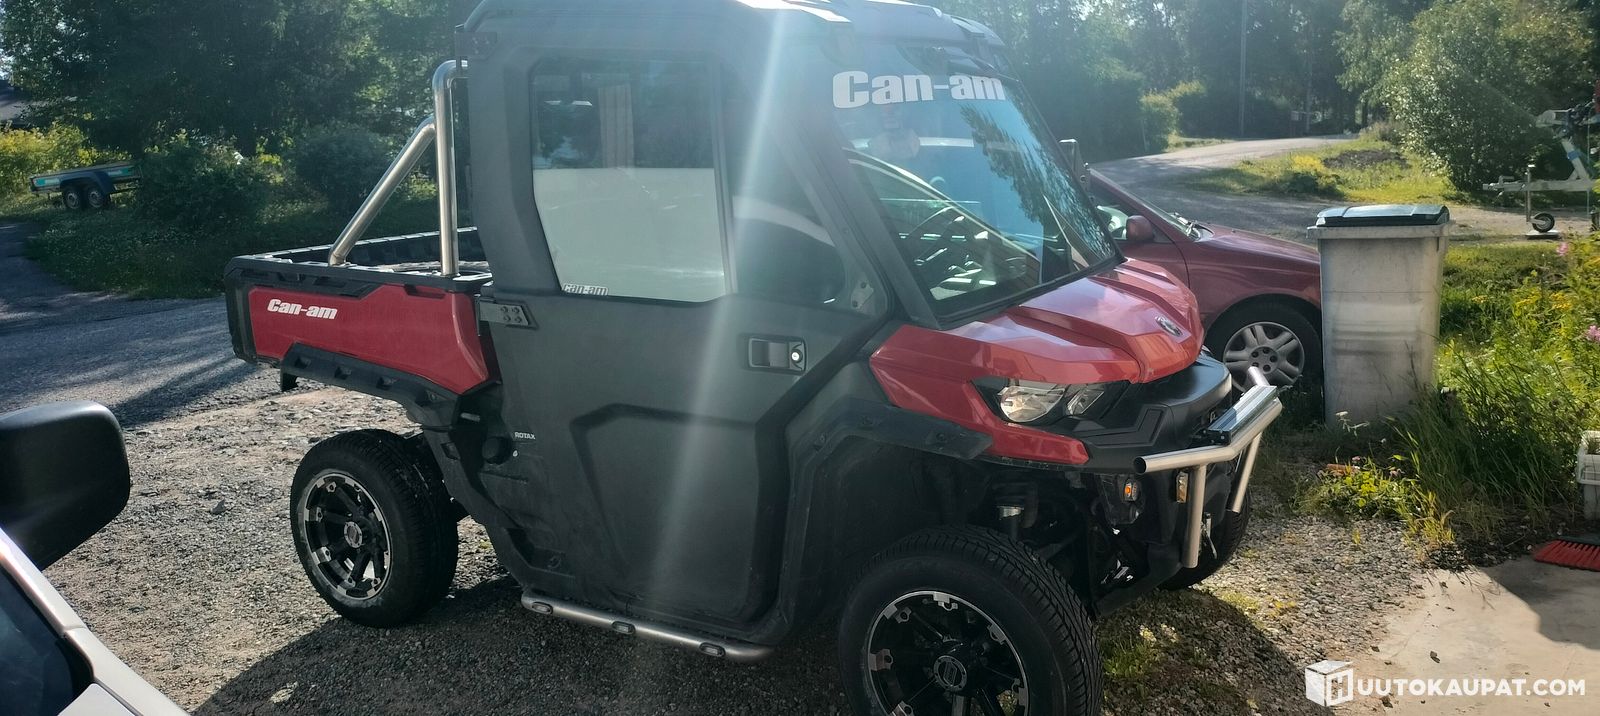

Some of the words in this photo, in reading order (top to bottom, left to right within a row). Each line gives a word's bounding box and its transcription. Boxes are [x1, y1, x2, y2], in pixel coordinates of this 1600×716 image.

[833, 71, 1005, 108] Can-am
[267, 298, 337, 319] Can-am
[515, 431, 536, 440] ROTAX
